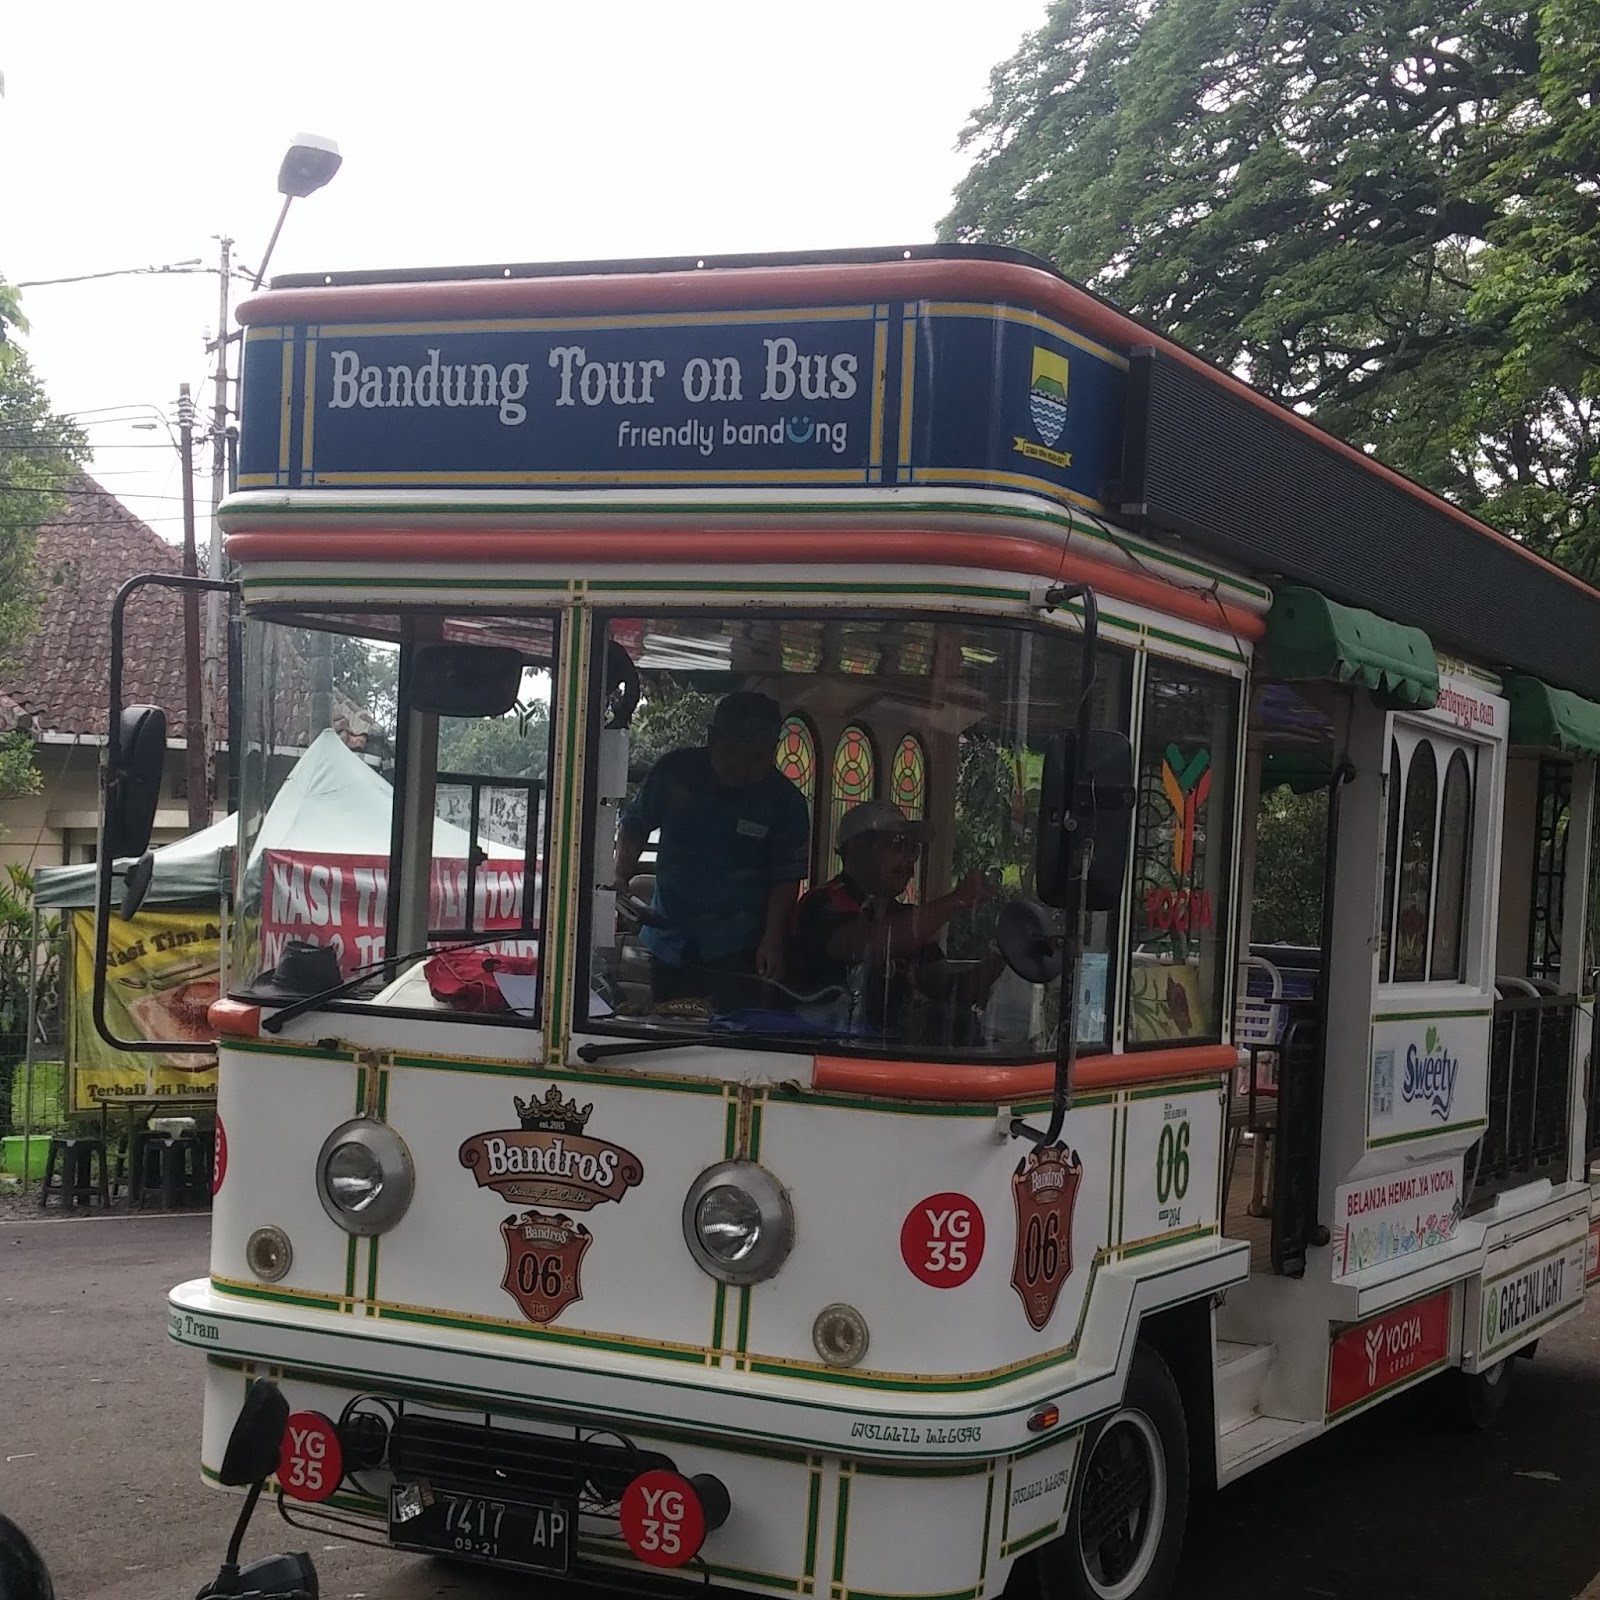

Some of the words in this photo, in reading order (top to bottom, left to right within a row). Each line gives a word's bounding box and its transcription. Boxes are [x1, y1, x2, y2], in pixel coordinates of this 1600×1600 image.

[328, 348, 530, 426] Bandung
[548, 345, 666, 408] Tour
[681, 354, 744, 402] on
[761, 336, 859, 402] Bus
[617, 418, 715, 456] friendly
[270, 862, 344, 927] NASI
[353, 866, 389, 929] TI
[150, 930, 200, 952] Tim
[1402, 1042, 1459, 1121] Sweety
[1156, 1120, 1191, 1204] 06
[1347, 1187, 1387, 1217] BELANJA
[1430, 1169, 1454, 1194] YOGYA
[925, 1209, 971, 1238] YG
[924, 1241, 967, 1272] 35
[1023, 1208, 1061, 1287] 06
[516, 1251, 563, 1298] 06
[185, 1315, 220, 1341] Tram
[1386, 1316, 1422, 1357] YOGYA
[288, 1426, 326, 1459] YG
[288, 1457, 325, 1491] 35
[443, 1494, 506, 1540] 7417
[532, 1510, 565, 1549] AP
[640, 1486, 685, 1521] YG
[640, 1520, 682, 1555] 35
